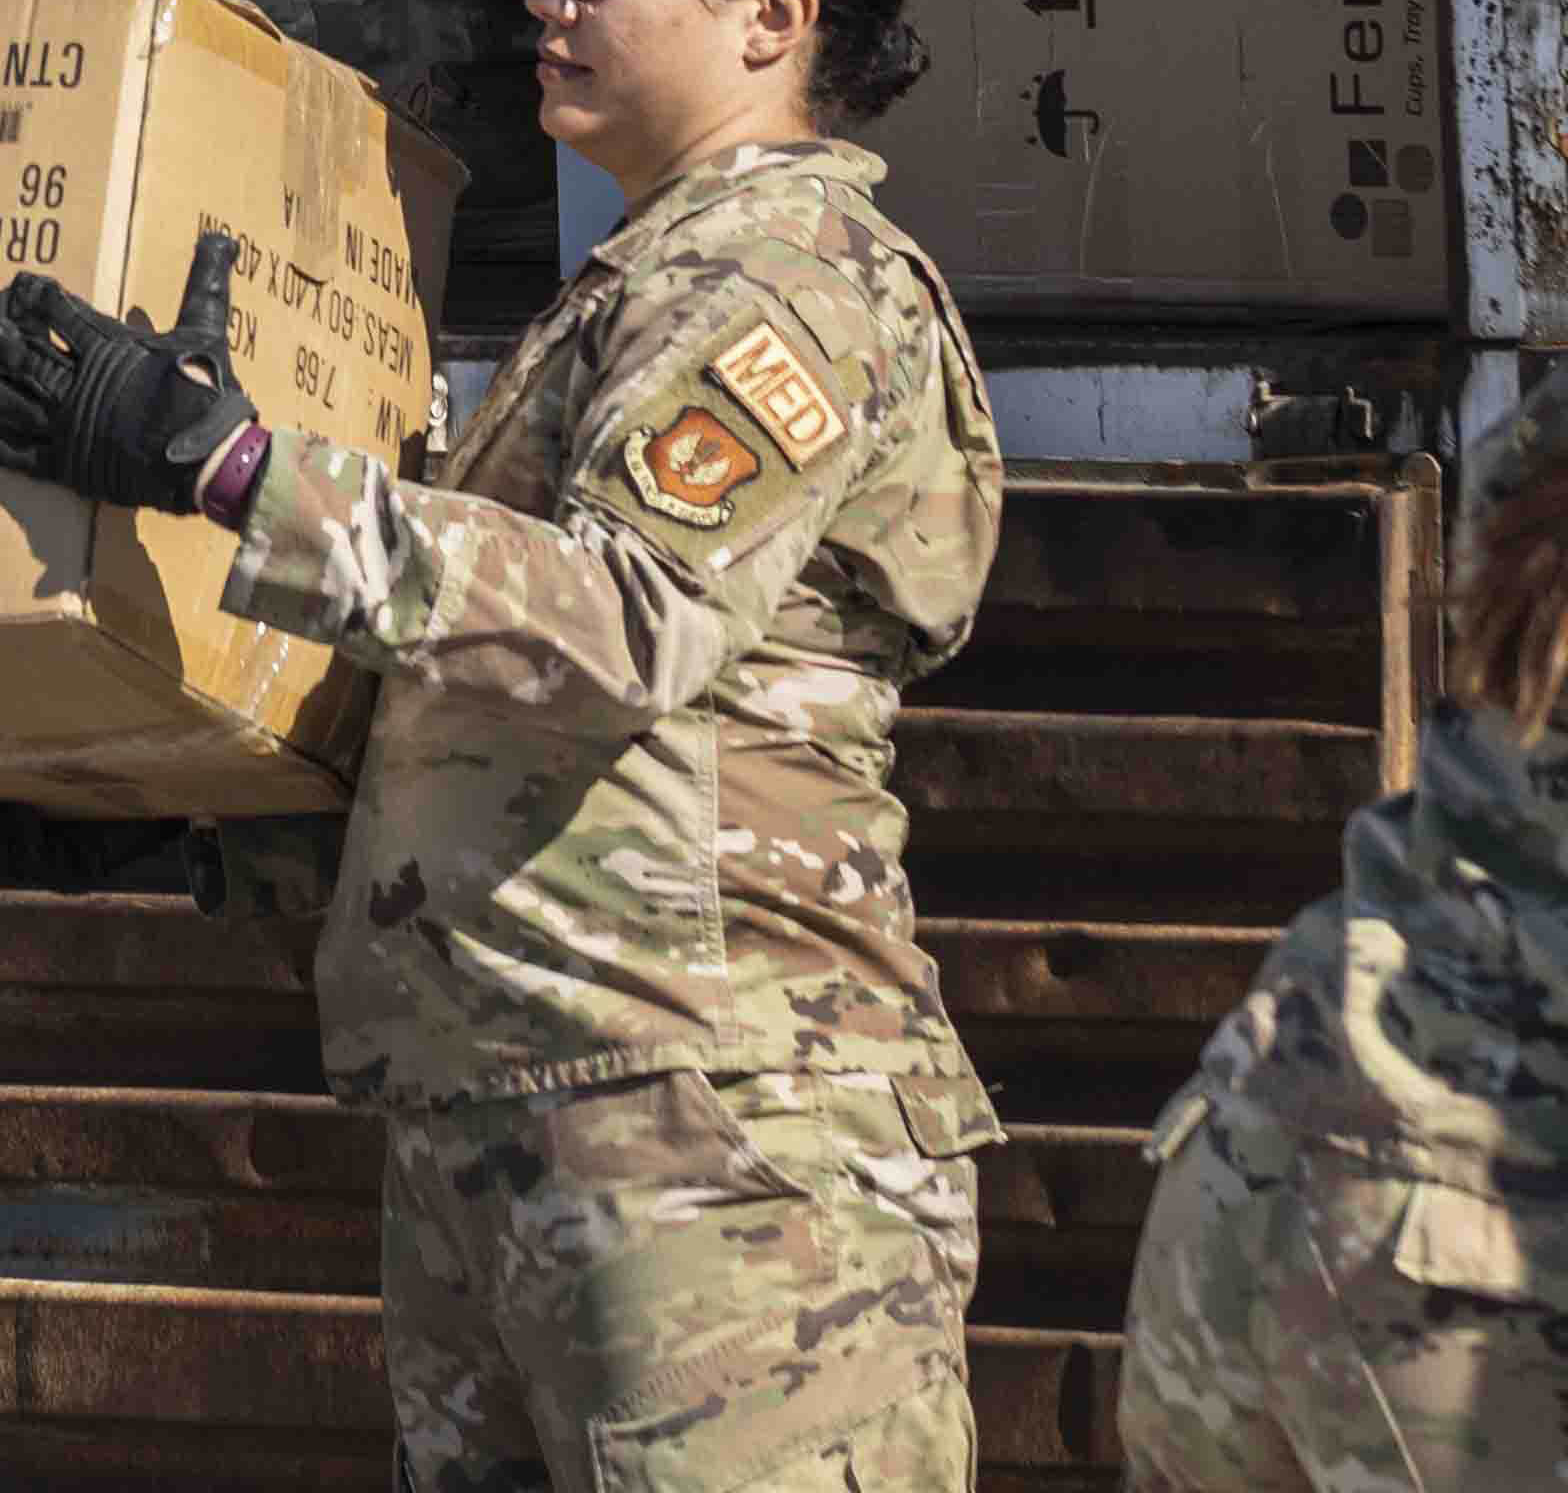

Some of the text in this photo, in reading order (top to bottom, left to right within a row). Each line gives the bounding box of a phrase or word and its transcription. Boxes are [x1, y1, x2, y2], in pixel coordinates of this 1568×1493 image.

[2, 41, 85, 90] CTN
[1405, 56, 1426, 117] Cups,
[18, 162, 67, 210] 96
[266, 252, 282, 297] X
[345, 222, 416, 311] MADE IN
[226, 305, 258, 362] KG
[294, 346, 337, 410] 7.68
[724, 333, 834, 451] MED
